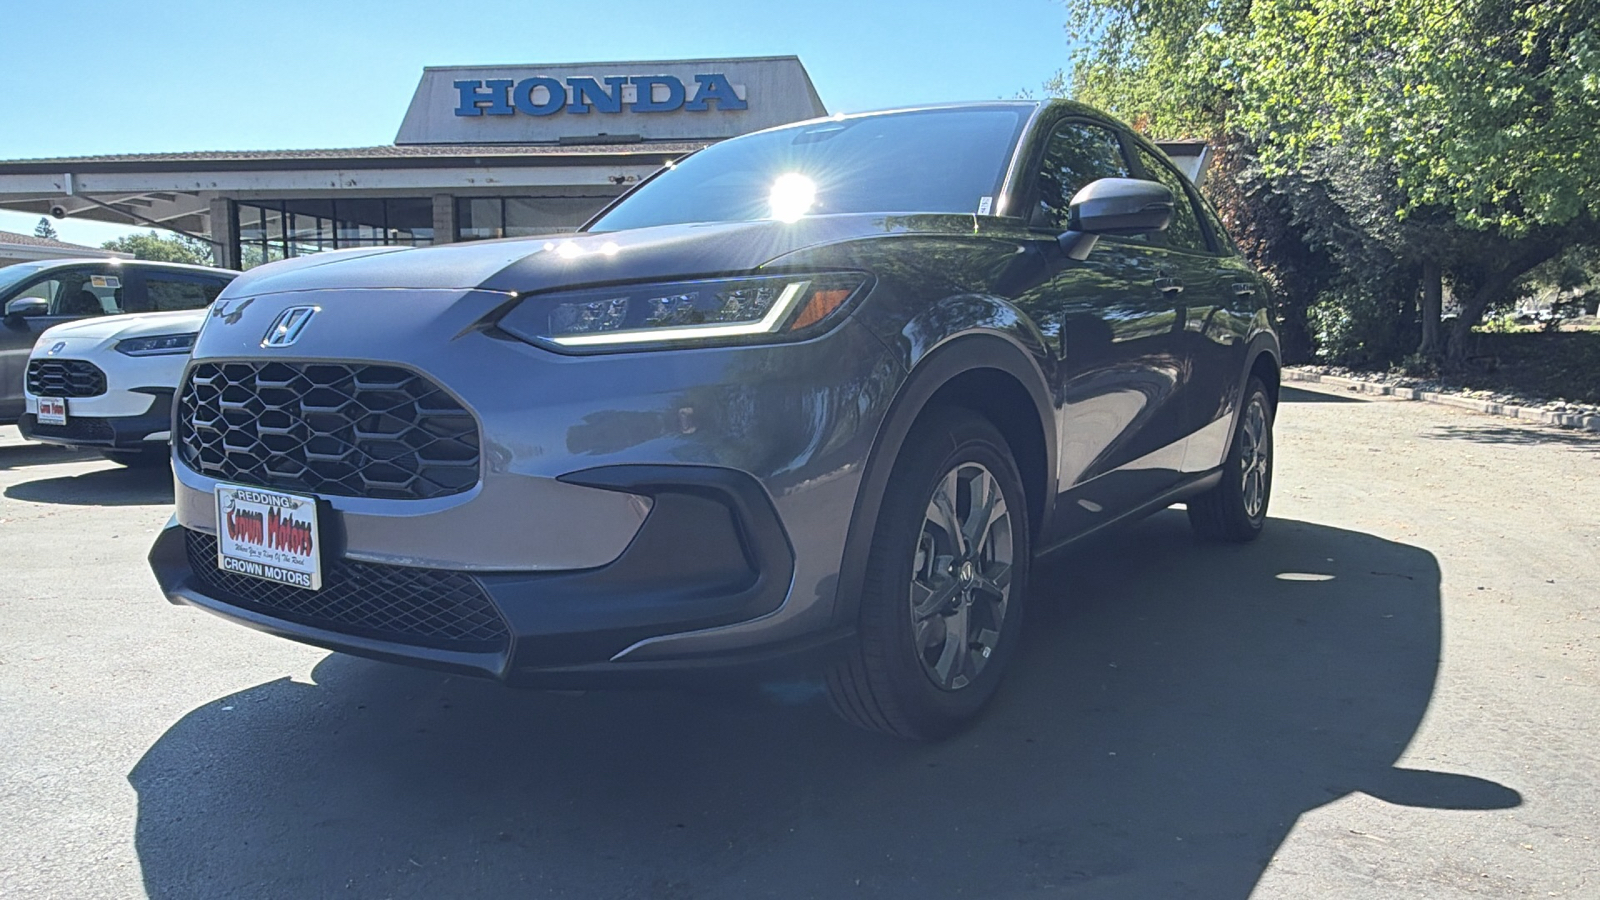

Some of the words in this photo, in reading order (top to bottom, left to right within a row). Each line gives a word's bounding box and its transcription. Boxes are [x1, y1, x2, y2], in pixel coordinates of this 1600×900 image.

[454, 73, 748, 117] HONDA
[237, 490, 290, 507] REDDING
[226, 499, 264, 547] Crown
[267, 506, 313, 557] Motors
[224, 557, 263, 576] CROWN
[264, 565, 311, 587] MOTORS
